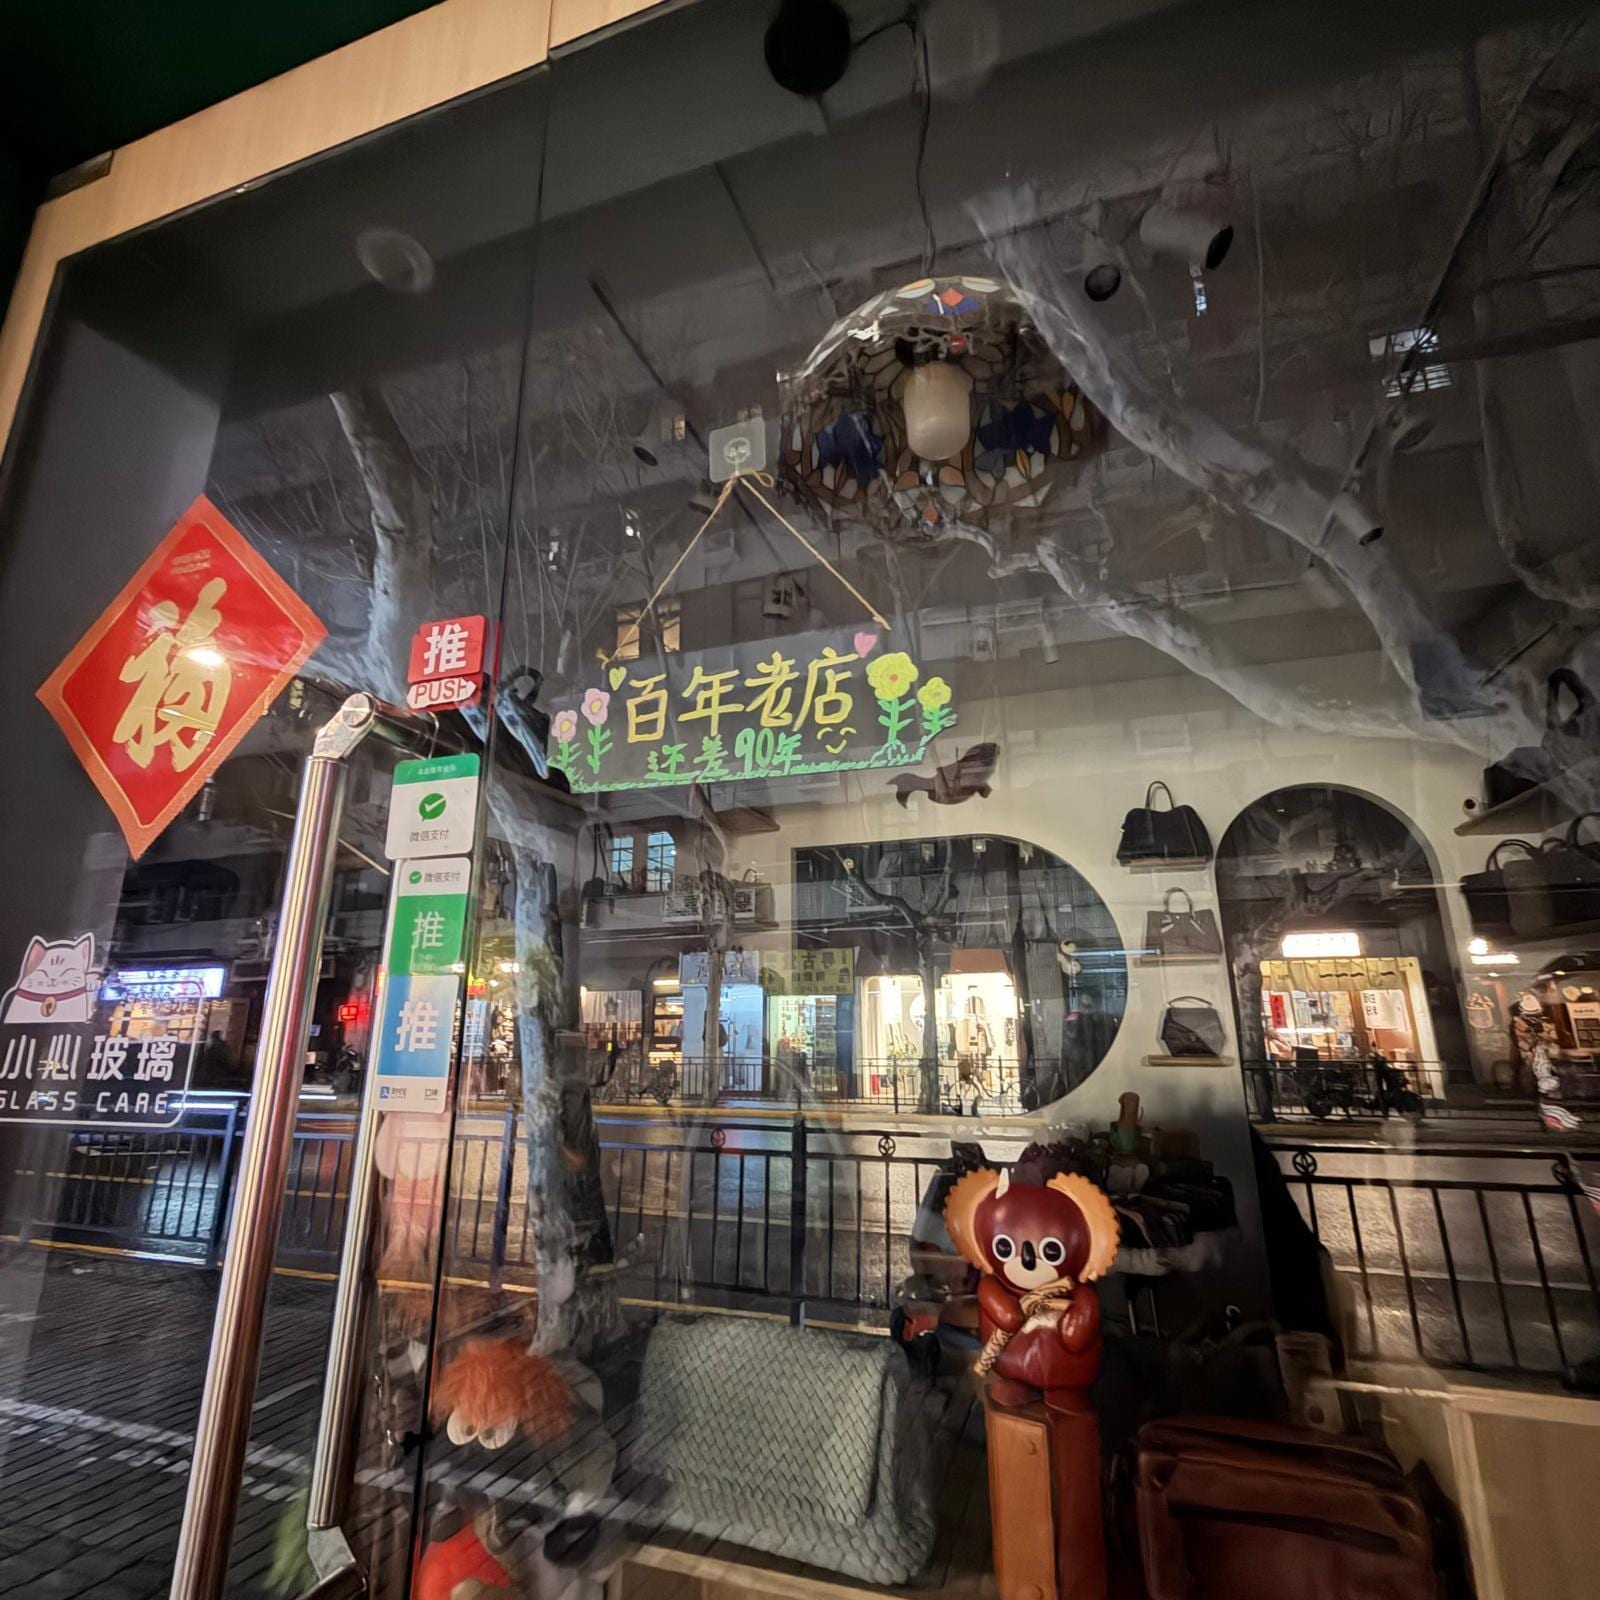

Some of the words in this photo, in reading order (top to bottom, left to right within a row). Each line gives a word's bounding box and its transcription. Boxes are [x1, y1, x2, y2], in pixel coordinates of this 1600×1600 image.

[423, 622, 469, 675] 推
[114, 577, 232, 772] 福
[414, 679, 467, 704] PUSH
[626, 646, 860, 744] 百年老店
[409, 829, 450, 842] 微信支付
[410, 911, 446, 949] 推
[394, 1001, 439, 1053] 推
[0, 1034, 178, 1082] 小心玻璃
[96, 1092, 169, 1114] CARE
